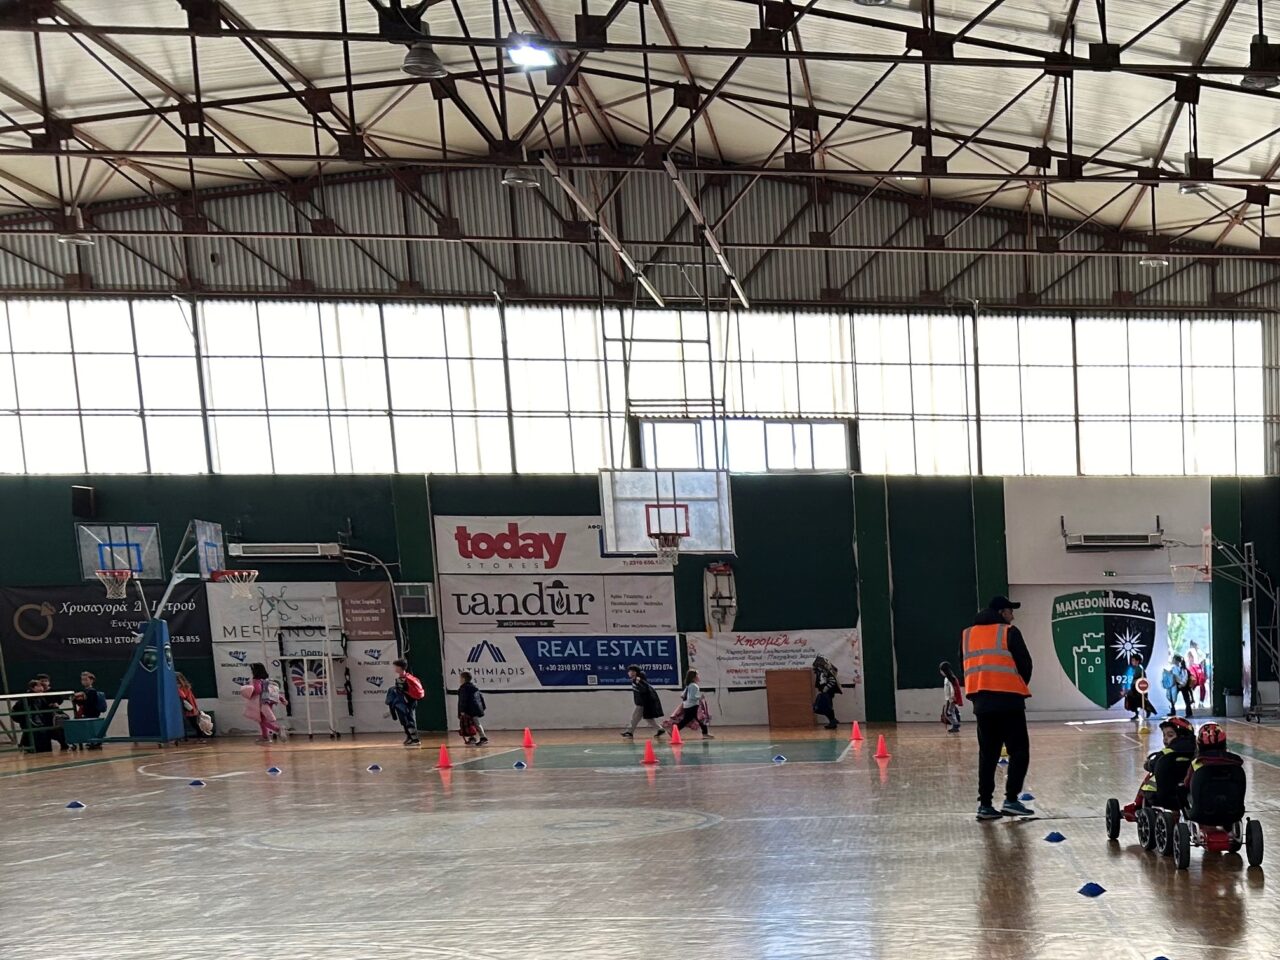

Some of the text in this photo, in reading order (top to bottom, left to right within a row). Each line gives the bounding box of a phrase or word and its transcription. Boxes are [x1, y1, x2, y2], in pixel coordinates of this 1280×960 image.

[454, 522, 567, 569] today
[60, 600, 128, 616] Χρυσαγορά
[1055, 597, 1130, 614] MAKEDONIKOS
[68, 637, 101, 645] ΤΣΙΜΙΣΚΗ
[537, 640, 669, 657] REAL ESTATE
